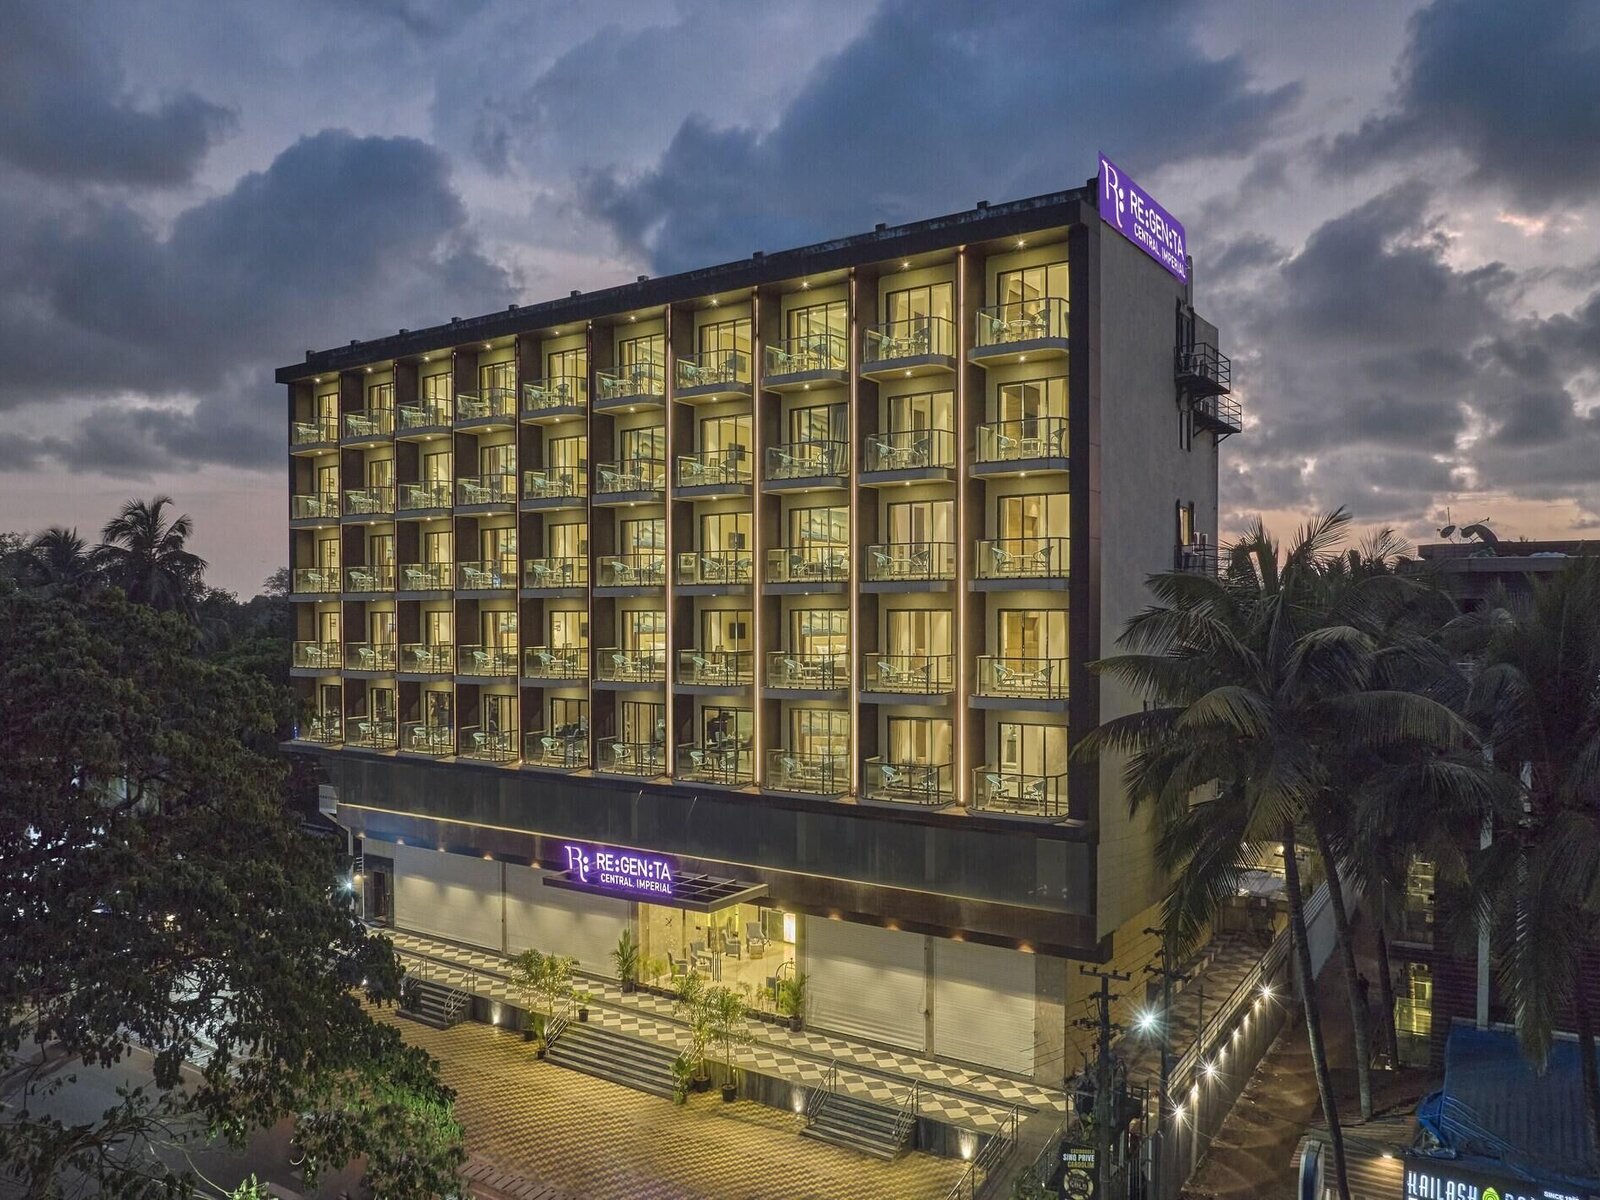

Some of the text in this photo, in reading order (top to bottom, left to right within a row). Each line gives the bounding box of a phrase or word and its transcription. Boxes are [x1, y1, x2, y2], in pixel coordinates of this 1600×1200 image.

[1134, 223, 1186, 278] CENTRAL IMPERIAL
[637, 879, 672, 894] IMPERIAL
[1407, 1171, 1478, 1200] KAILASH
